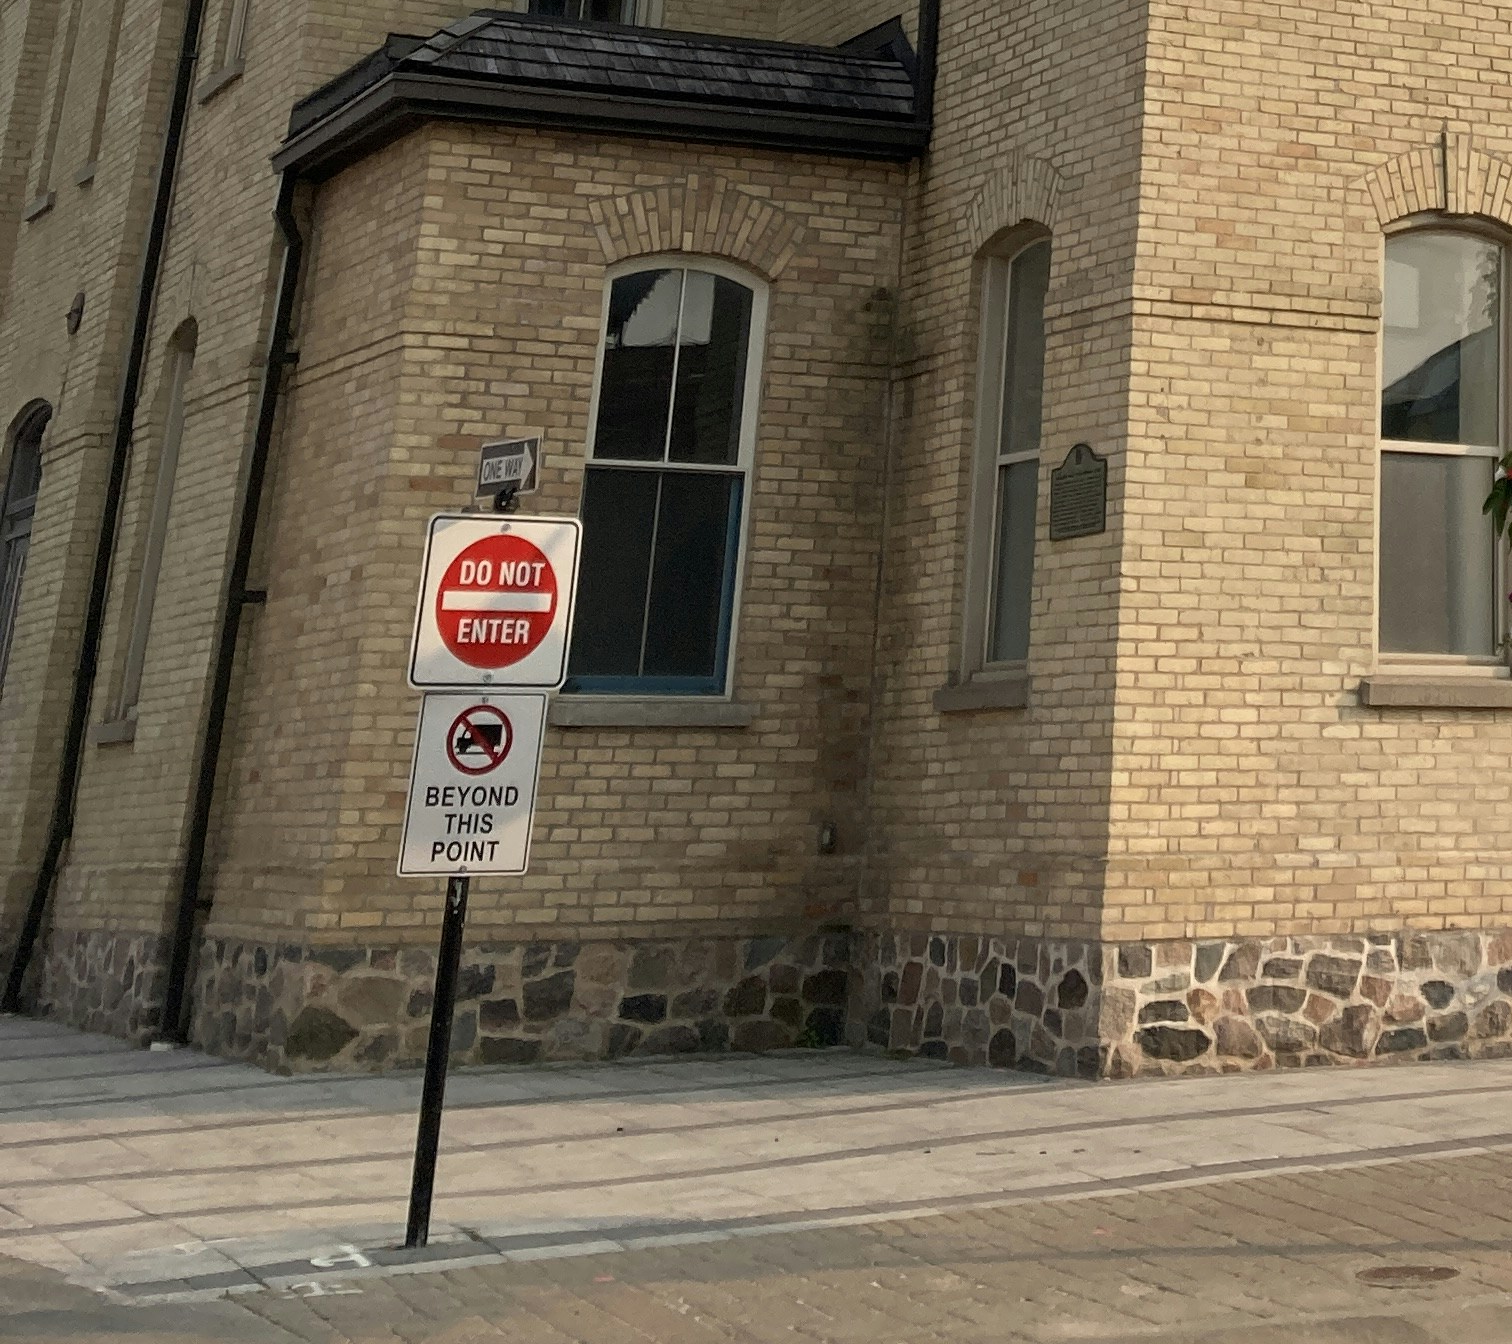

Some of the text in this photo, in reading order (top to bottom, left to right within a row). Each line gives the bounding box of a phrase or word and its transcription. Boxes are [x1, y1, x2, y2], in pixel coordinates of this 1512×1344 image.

[483, 456, 524, 481] ONE WAY
[459, 560, 546, 587] DO NOT
[457, 618, 530, 644] ENTER
[425, 786, 519, 807] BEYOND
[444, 813, 493, 834] THIS
[431, 840, 500, 862] POINT
